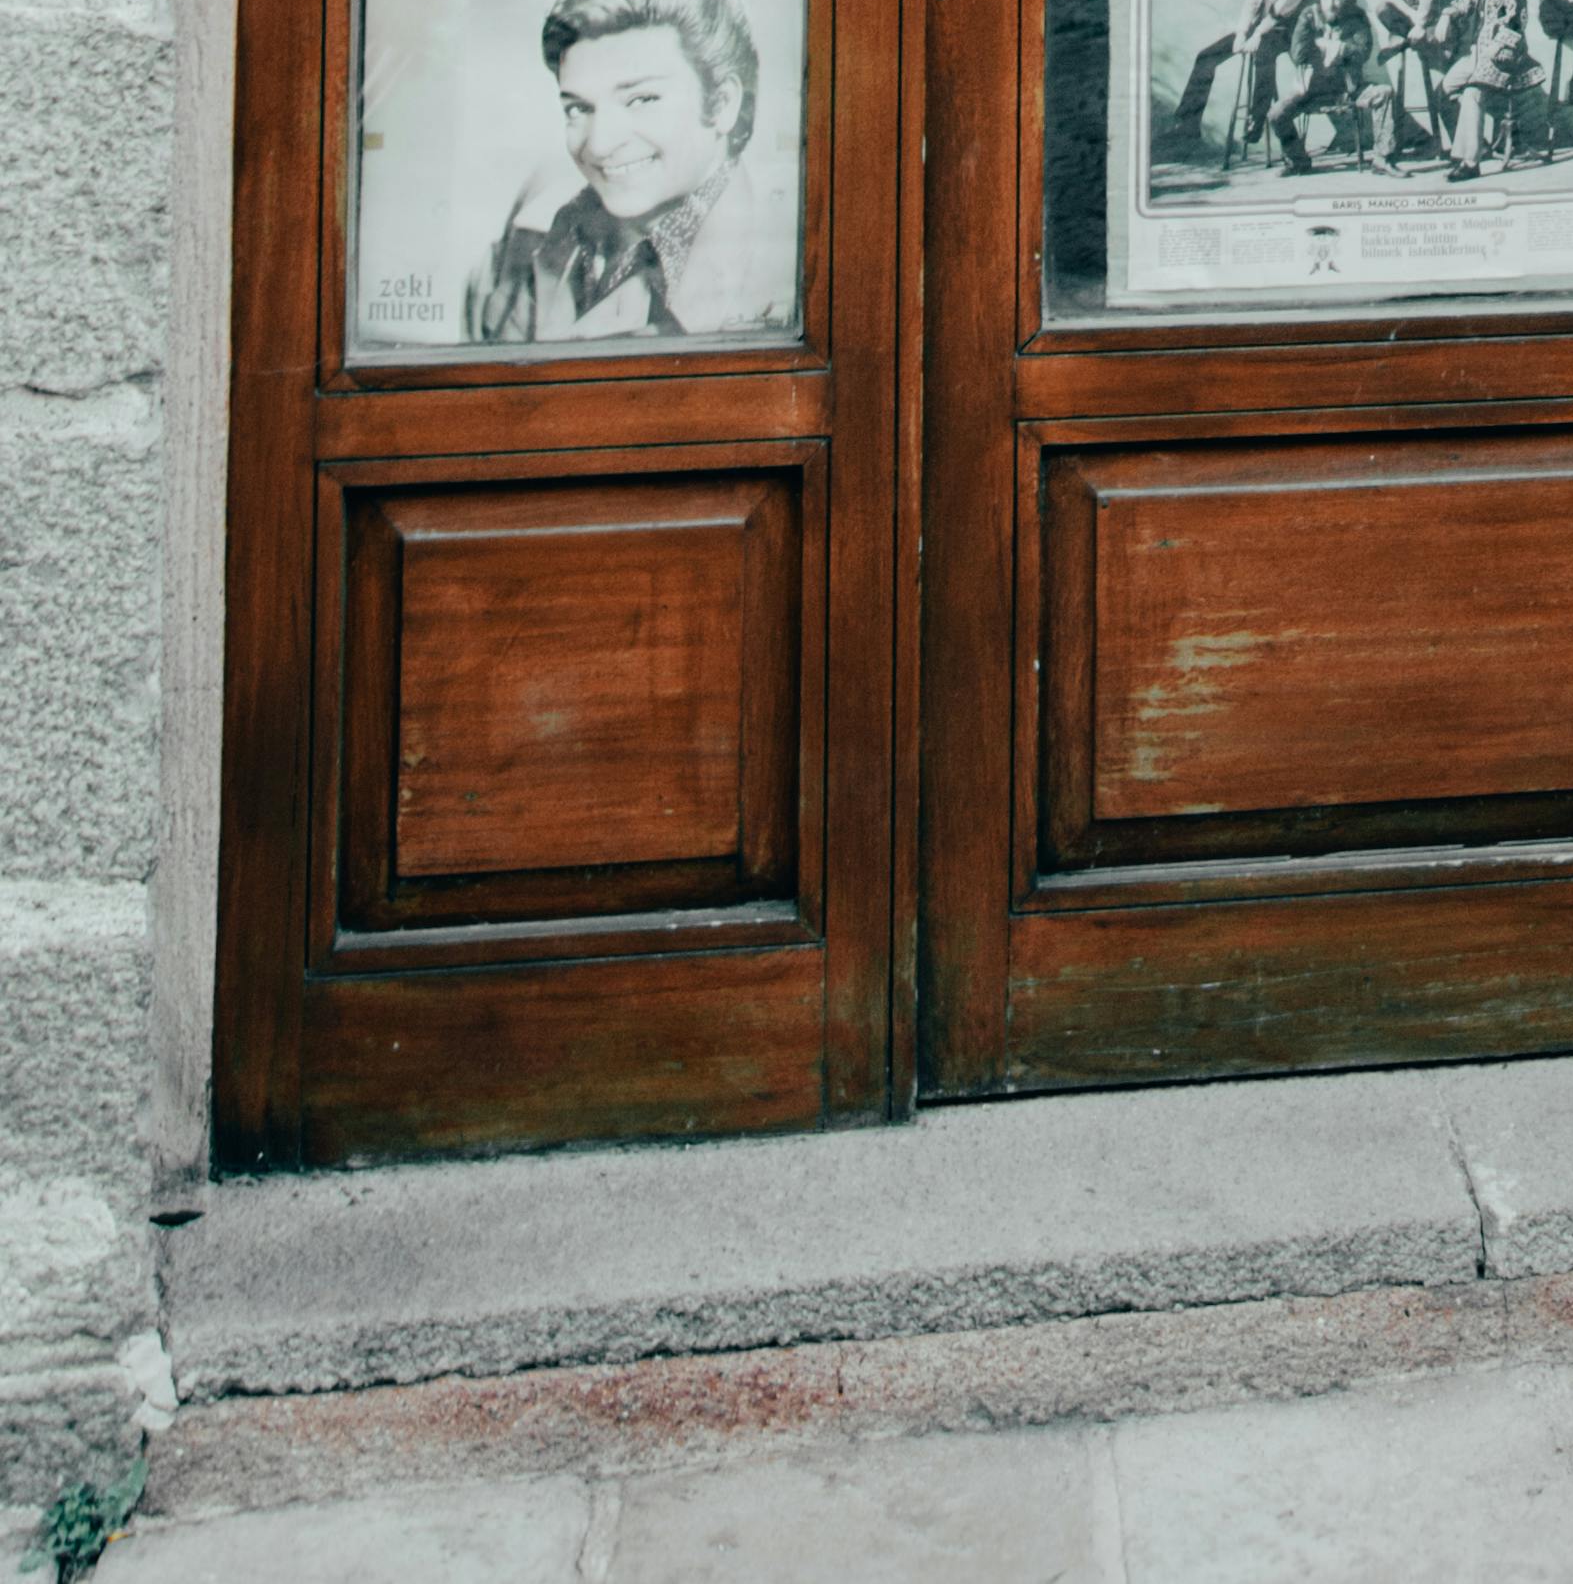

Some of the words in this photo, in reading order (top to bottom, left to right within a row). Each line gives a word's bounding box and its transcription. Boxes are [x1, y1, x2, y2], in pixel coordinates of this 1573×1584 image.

[1331, 199, 1363, 211] BARIŞ
[1368, 197, 1409, 211] MANÇO
[1416, 194, 1478, 208] MOĞOLLAR
[379, 273, 433, 298] zeki
[367, 298, 446, 322] müren
